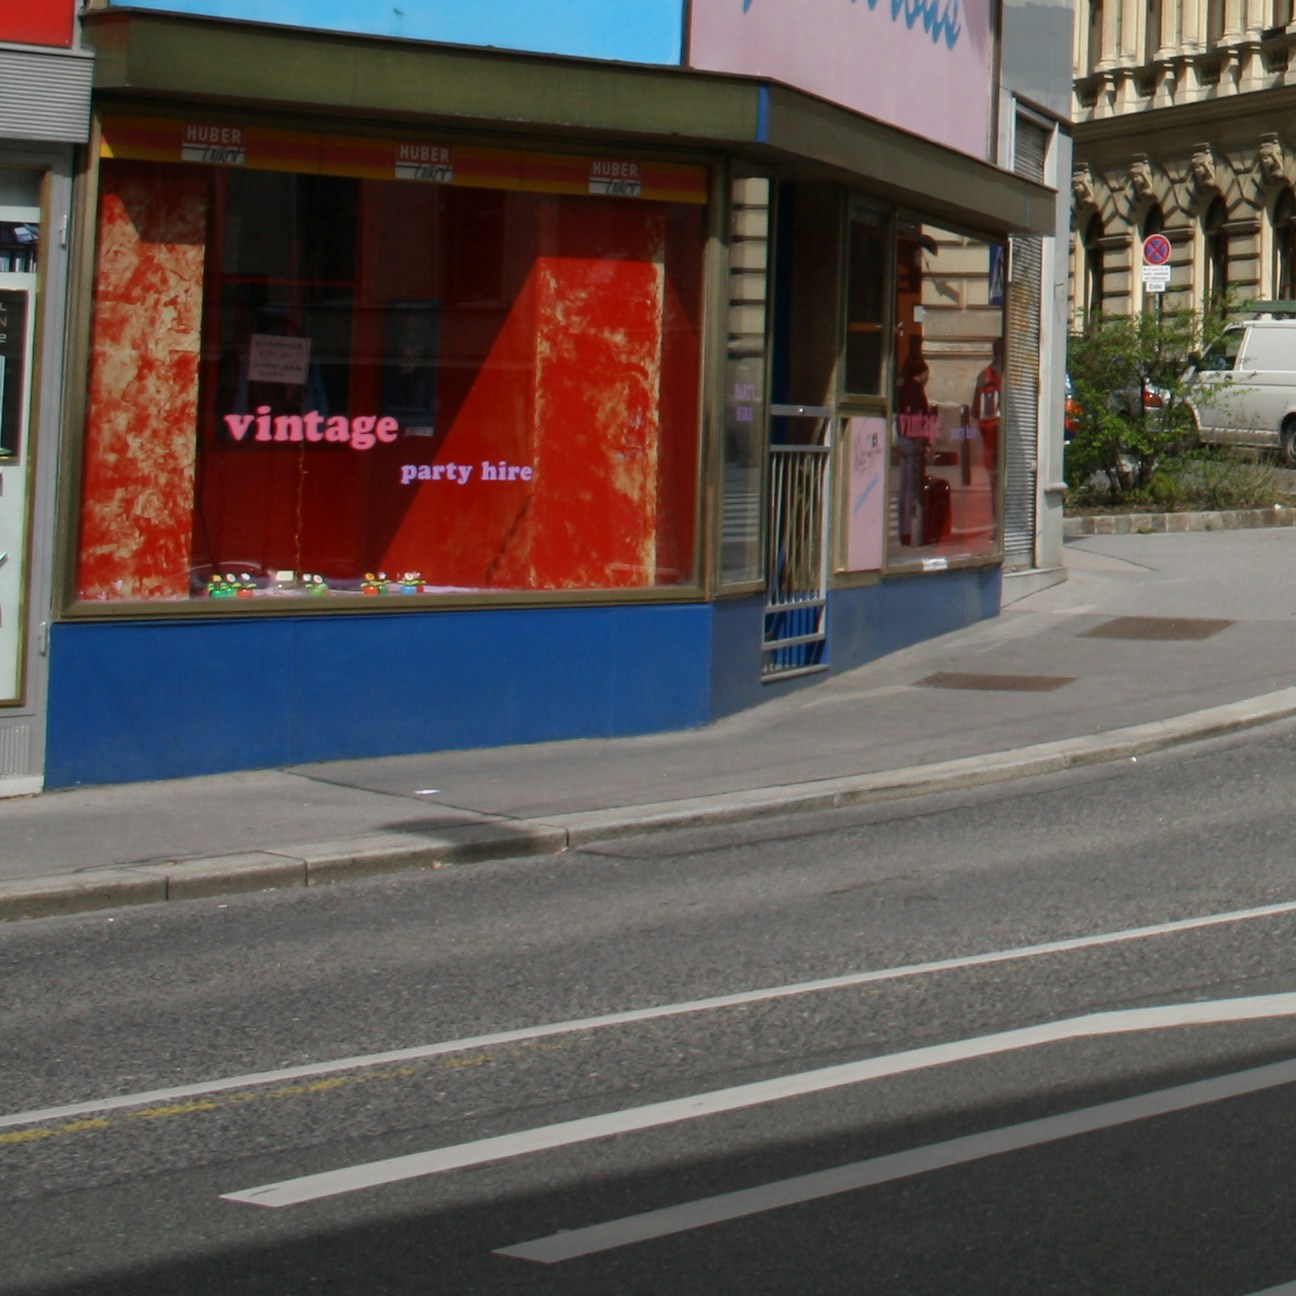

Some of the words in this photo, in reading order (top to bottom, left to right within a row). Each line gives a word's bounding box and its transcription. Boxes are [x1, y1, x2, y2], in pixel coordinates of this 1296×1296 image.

[186, 125, 242, 144] HUBER
[399, 144, 450, 163] HUBER
[592, 161, 639, 177] HUBER
[223, 405, 399, 450] vintage
[401, 461, 472, 485] party
[481, 461, 533, 482] hire
